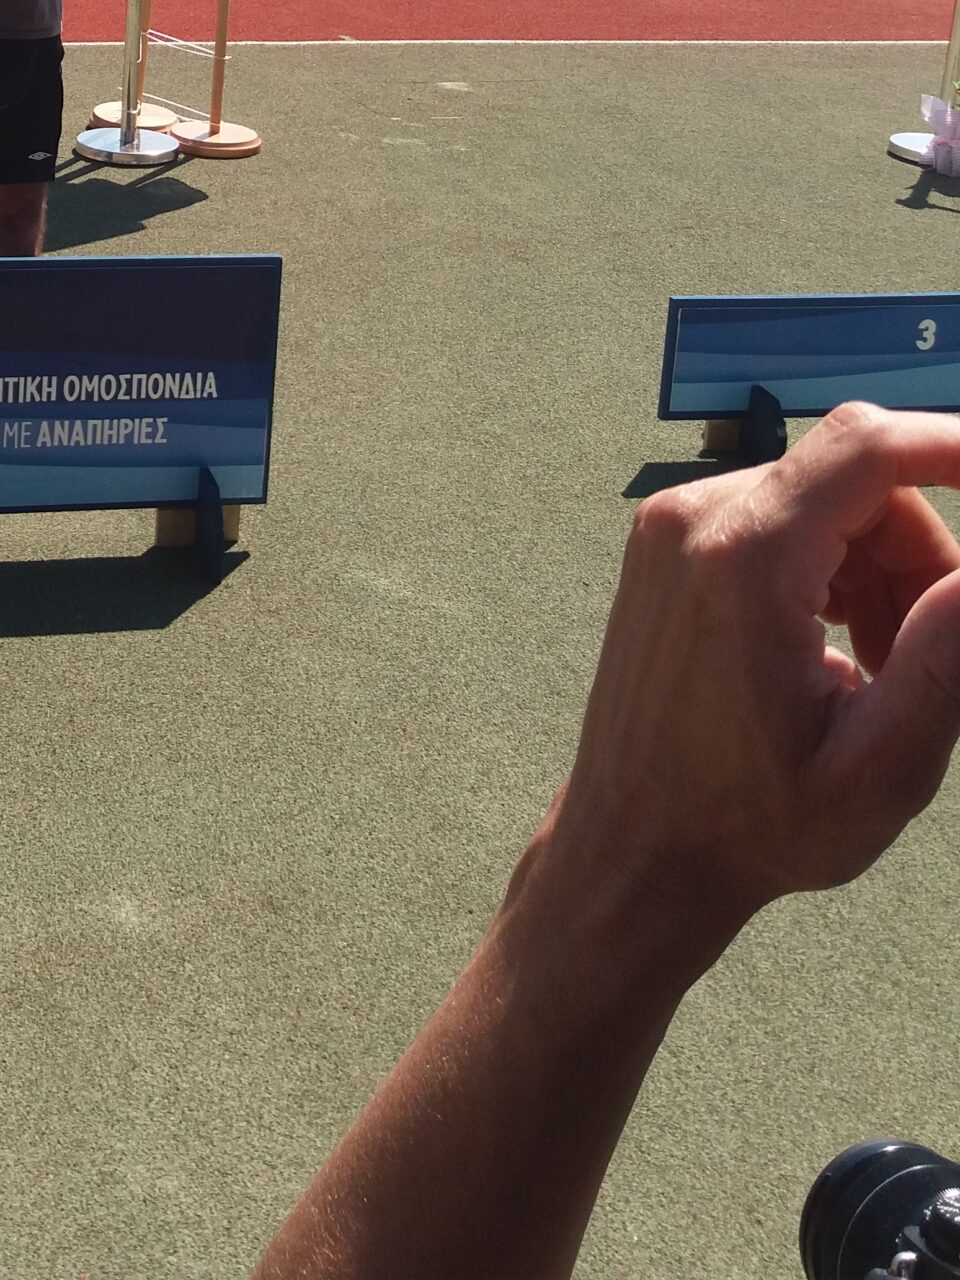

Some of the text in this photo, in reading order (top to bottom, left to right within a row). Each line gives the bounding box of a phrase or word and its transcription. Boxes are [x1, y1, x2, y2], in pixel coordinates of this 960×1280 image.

[915, 318, 936, 350] 3
[63, 372, 218, 402] ΟΜΟΣΠΟΝΔΙΑ
[2, 421, 31, 448] ΜΕ
[36, 417, 168, 447] ΑΝΑΠΗΡΙΕΣ
